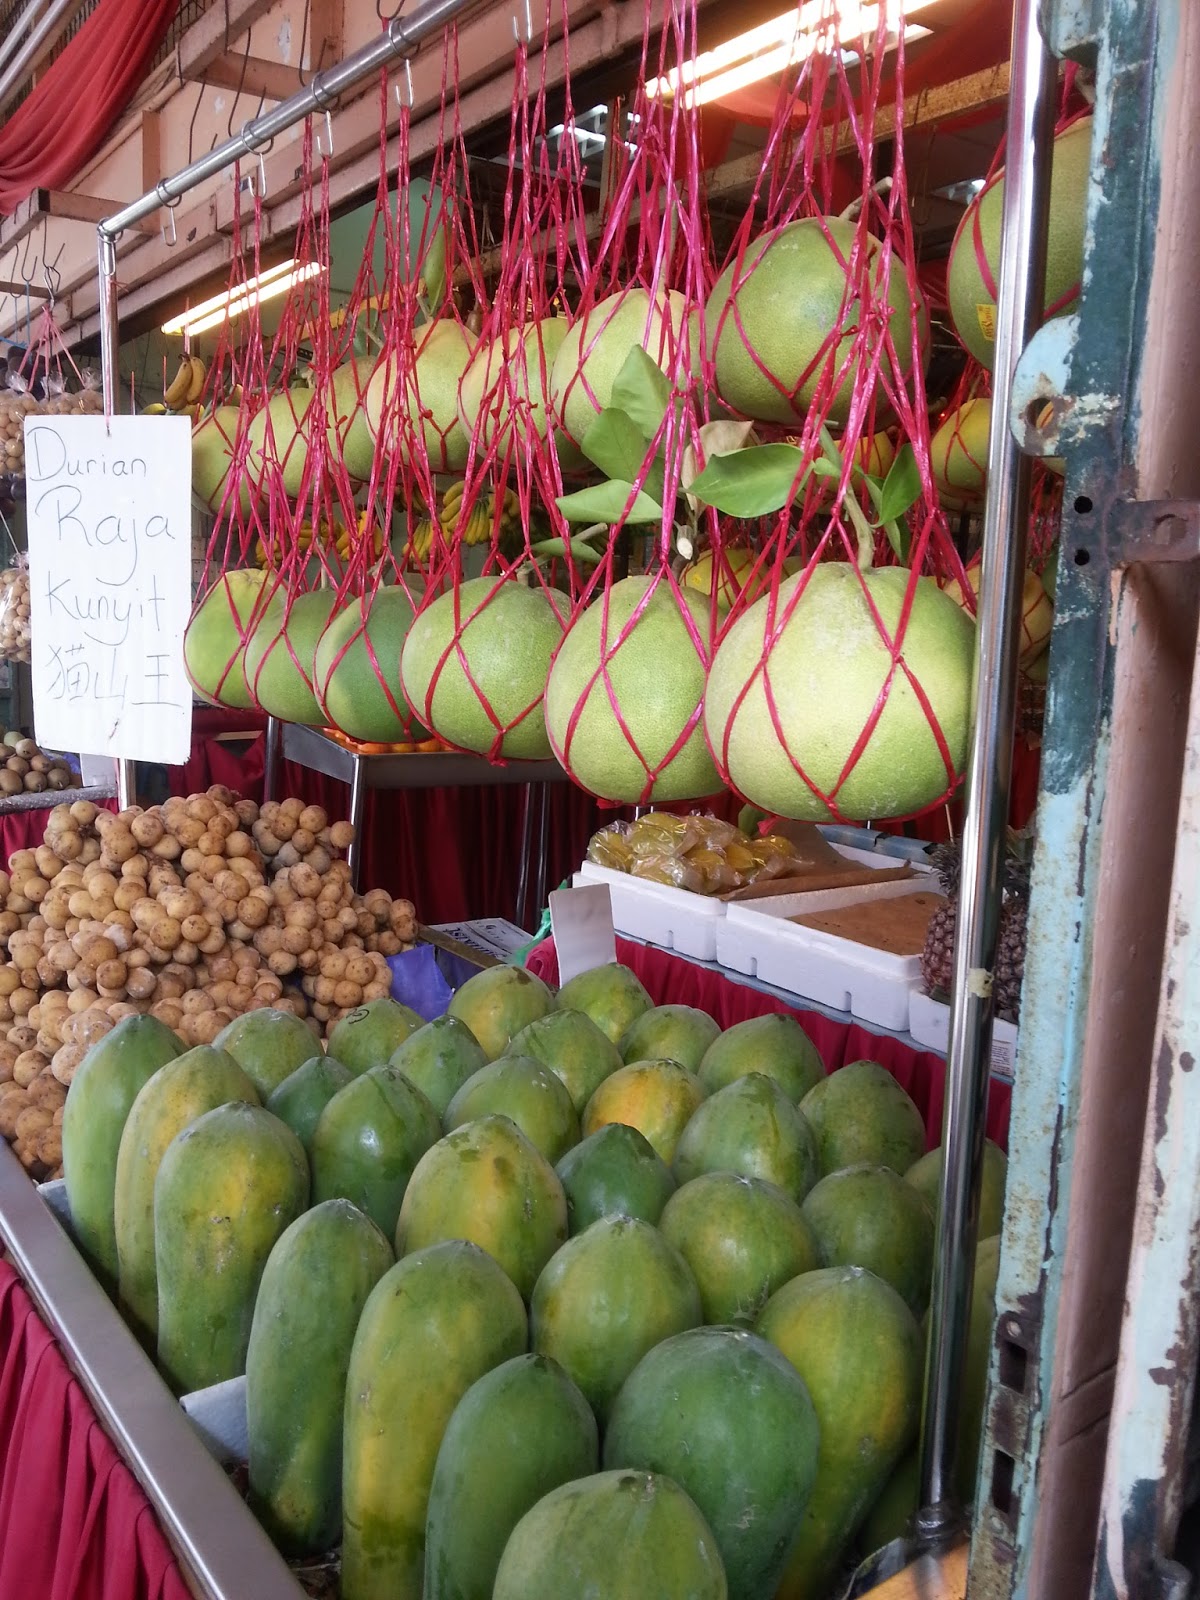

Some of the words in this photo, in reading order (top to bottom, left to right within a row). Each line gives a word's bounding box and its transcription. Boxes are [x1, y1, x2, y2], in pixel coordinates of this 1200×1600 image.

[27, 427, 147, 481] Durian
[35, 485, 176, 586] Raja
[45, 570, 166, 646] Kunyit
[45, 643, 184, 708] 猫山王
